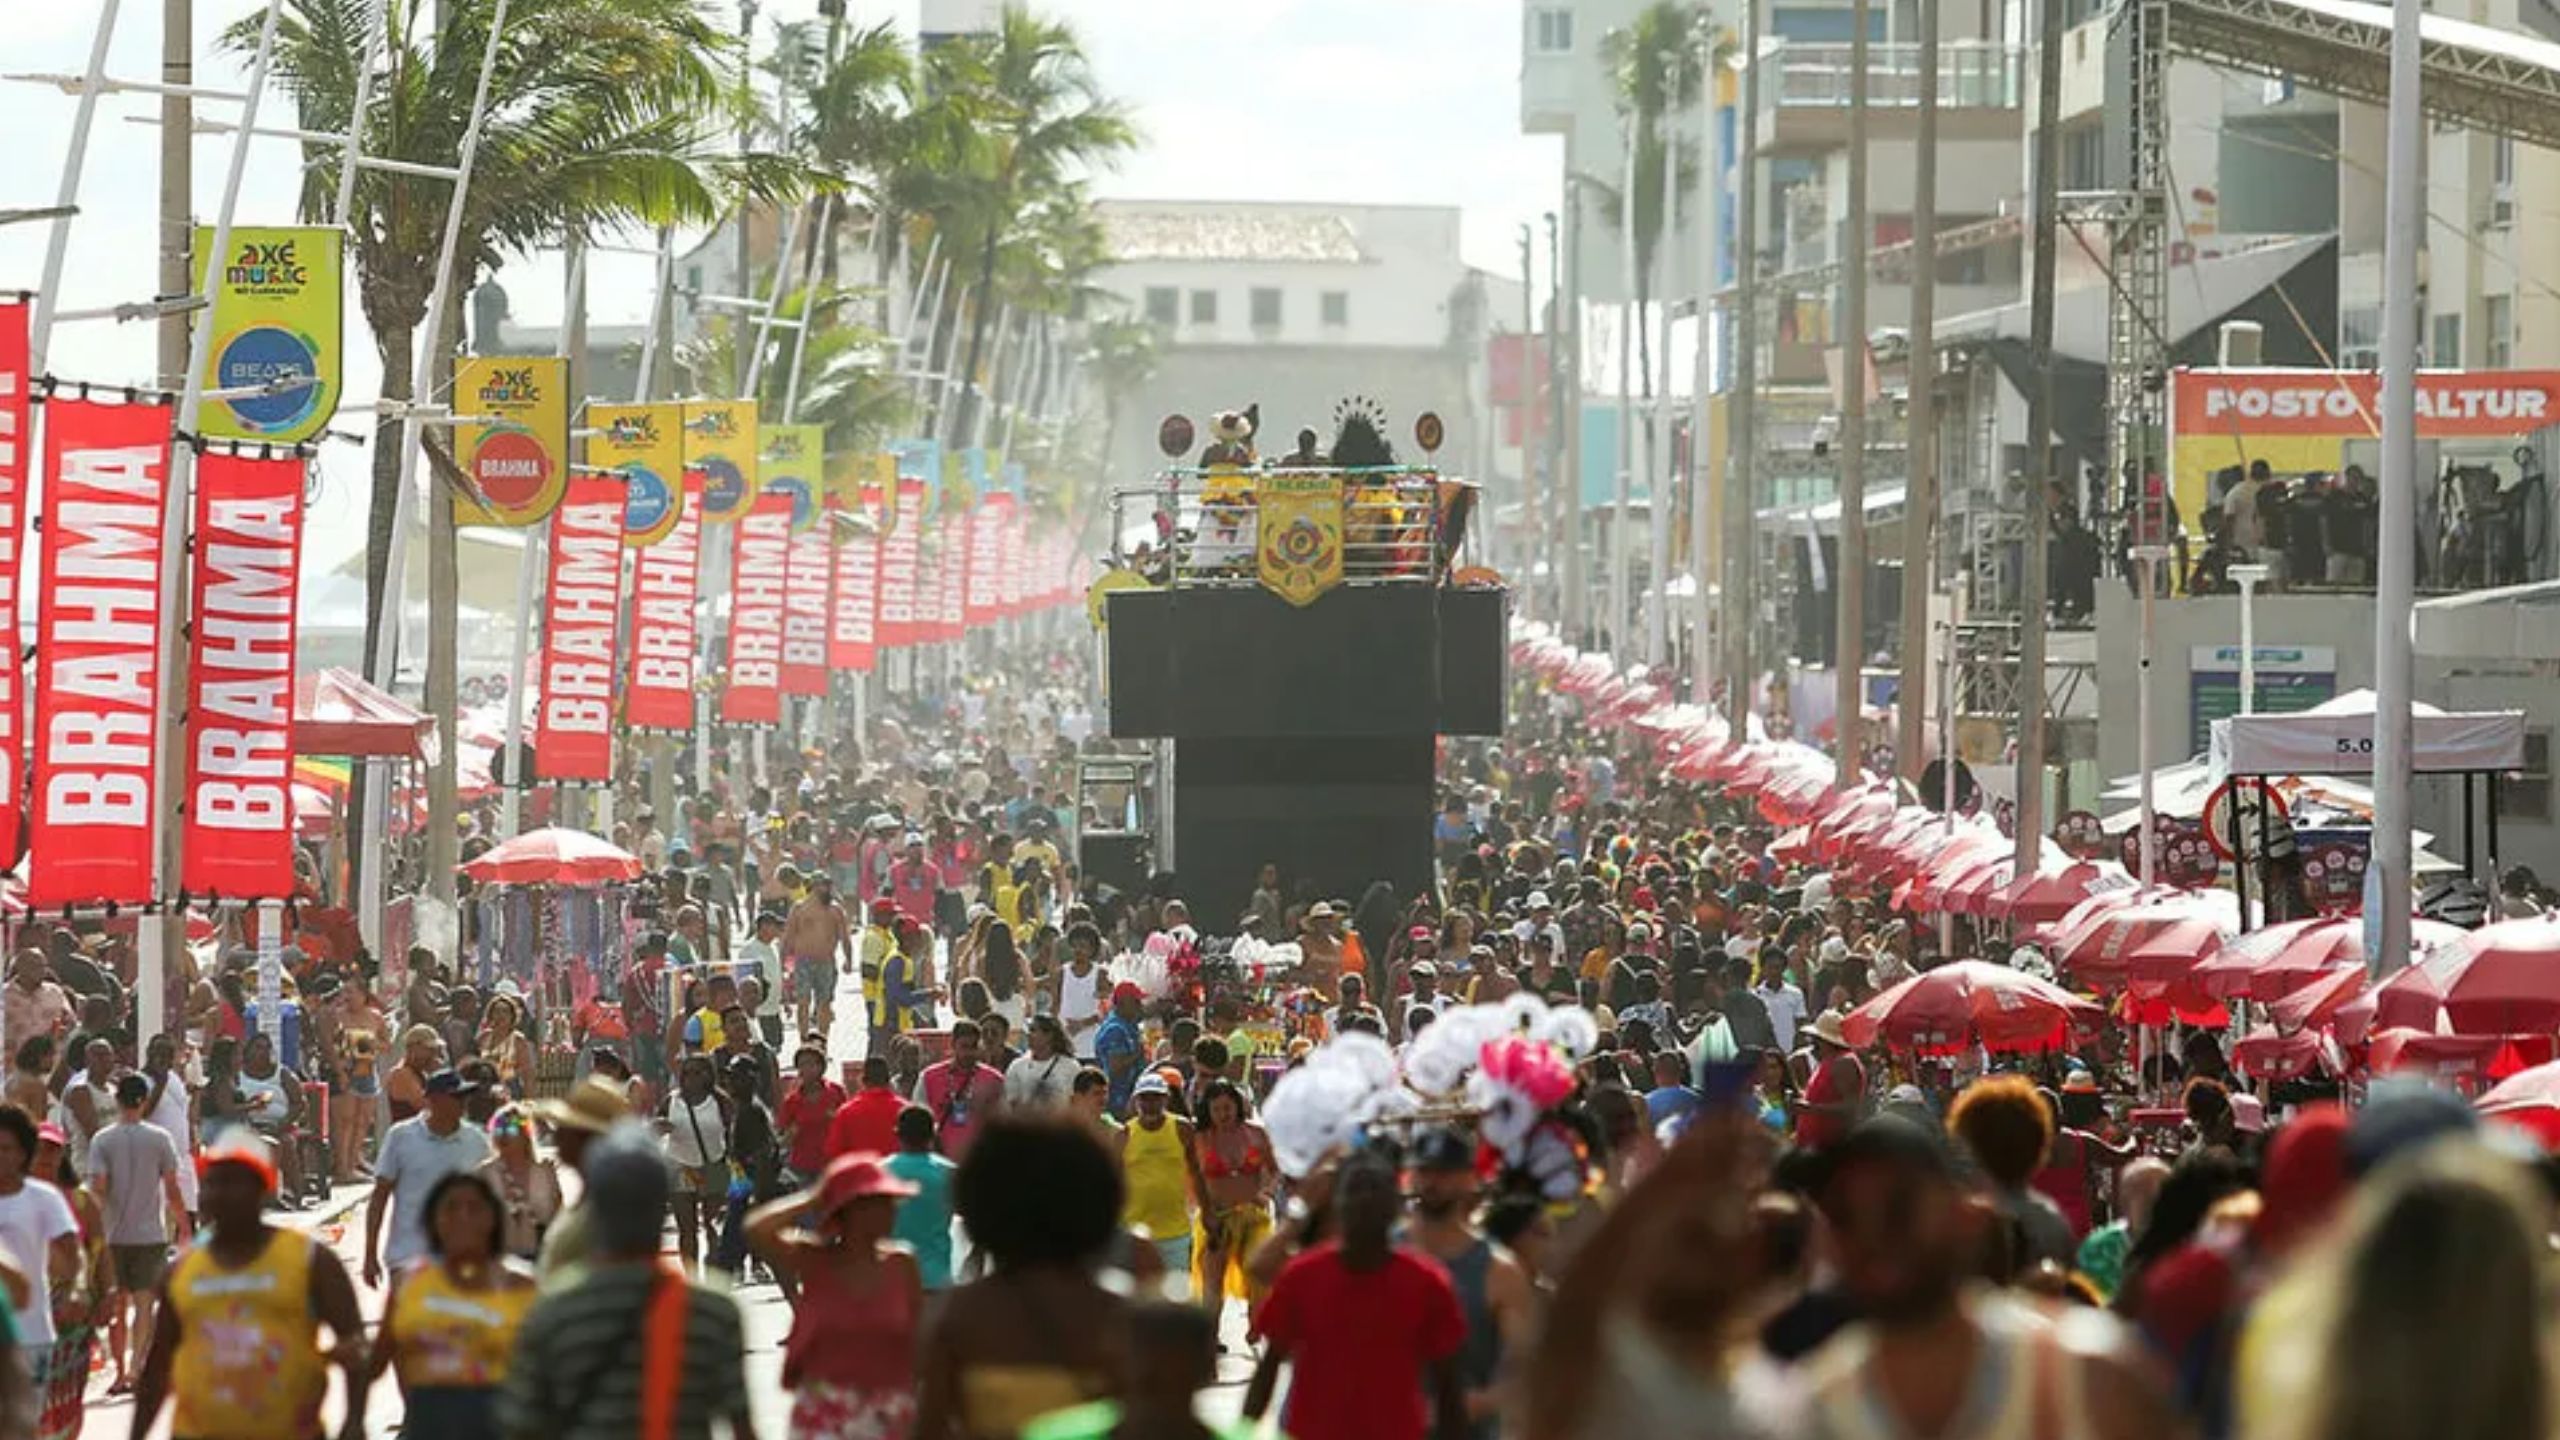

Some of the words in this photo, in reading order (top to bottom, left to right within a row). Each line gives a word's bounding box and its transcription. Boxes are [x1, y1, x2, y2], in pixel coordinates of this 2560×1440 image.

[481, 459, 539, 477] BRAHMA
[2206, 388, 2358, 417] POSTO
[2375, 388, 2547, 418] ALTUR
[48, 444, 163, 827] BRAHMA
[197, 494, 297, 831] BRAHMA
[549, 502, 624, 733] BRAHMA
[732, 512, 791, 687] BRAHMA
